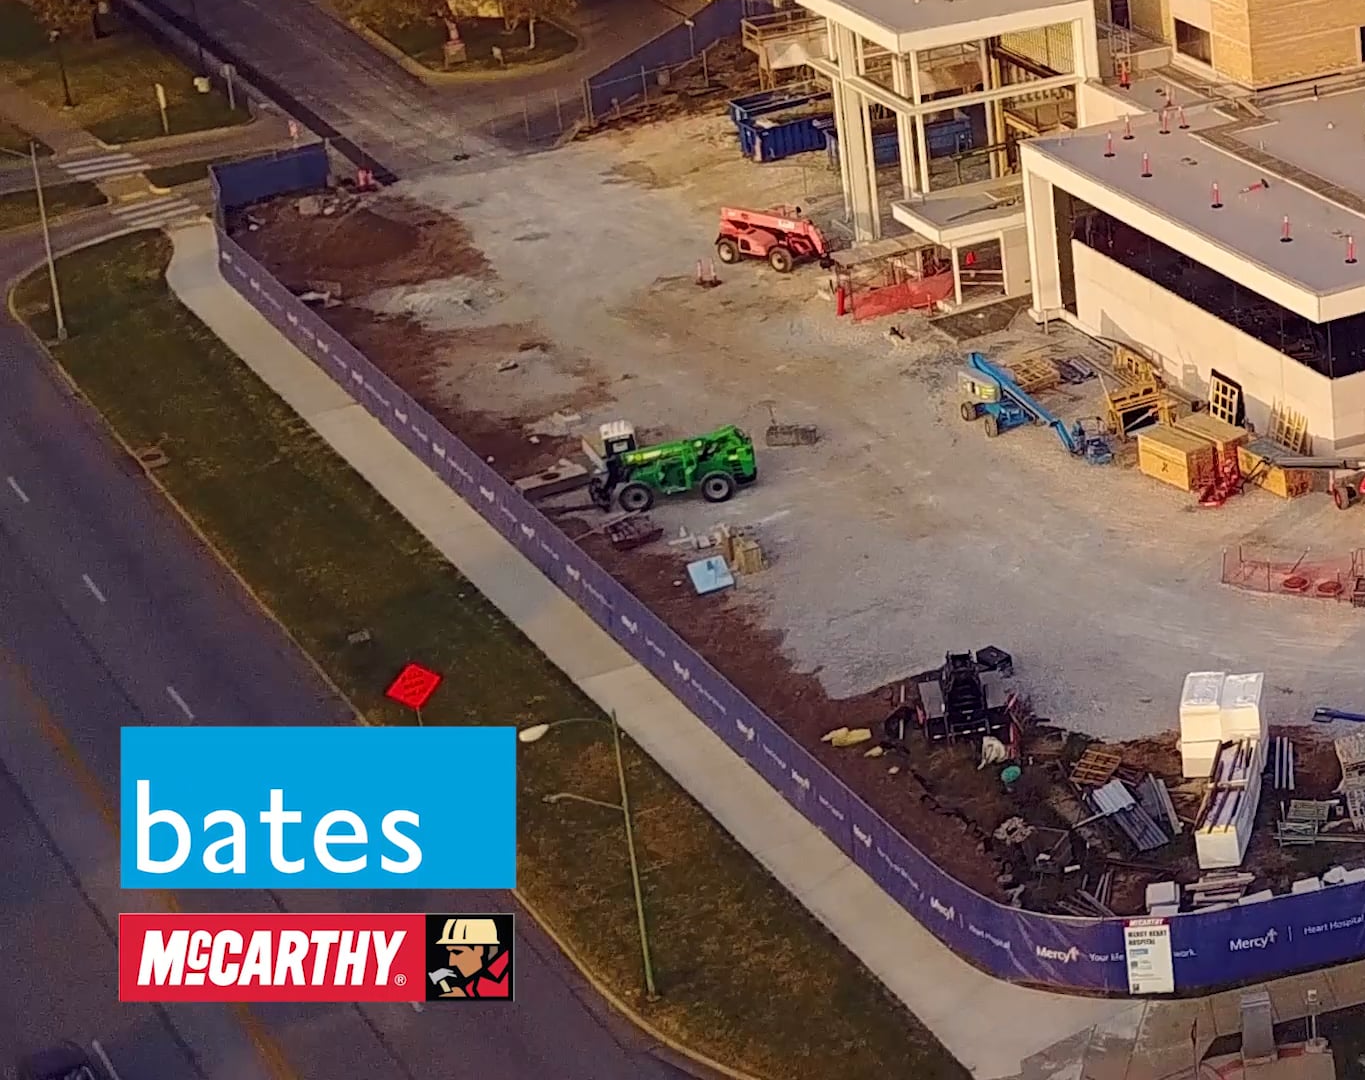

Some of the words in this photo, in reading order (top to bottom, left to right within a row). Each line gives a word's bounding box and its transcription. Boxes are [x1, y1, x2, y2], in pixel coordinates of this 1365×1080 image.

[1303, 922, 1328, 935] Heart
[1329, 914, 1364, 931] Hospital
[1229, 934, 1270, 952] Mercy
[1036, 944, 1069, 964] Mercy
[1088, 951, 1109, 962] Your
